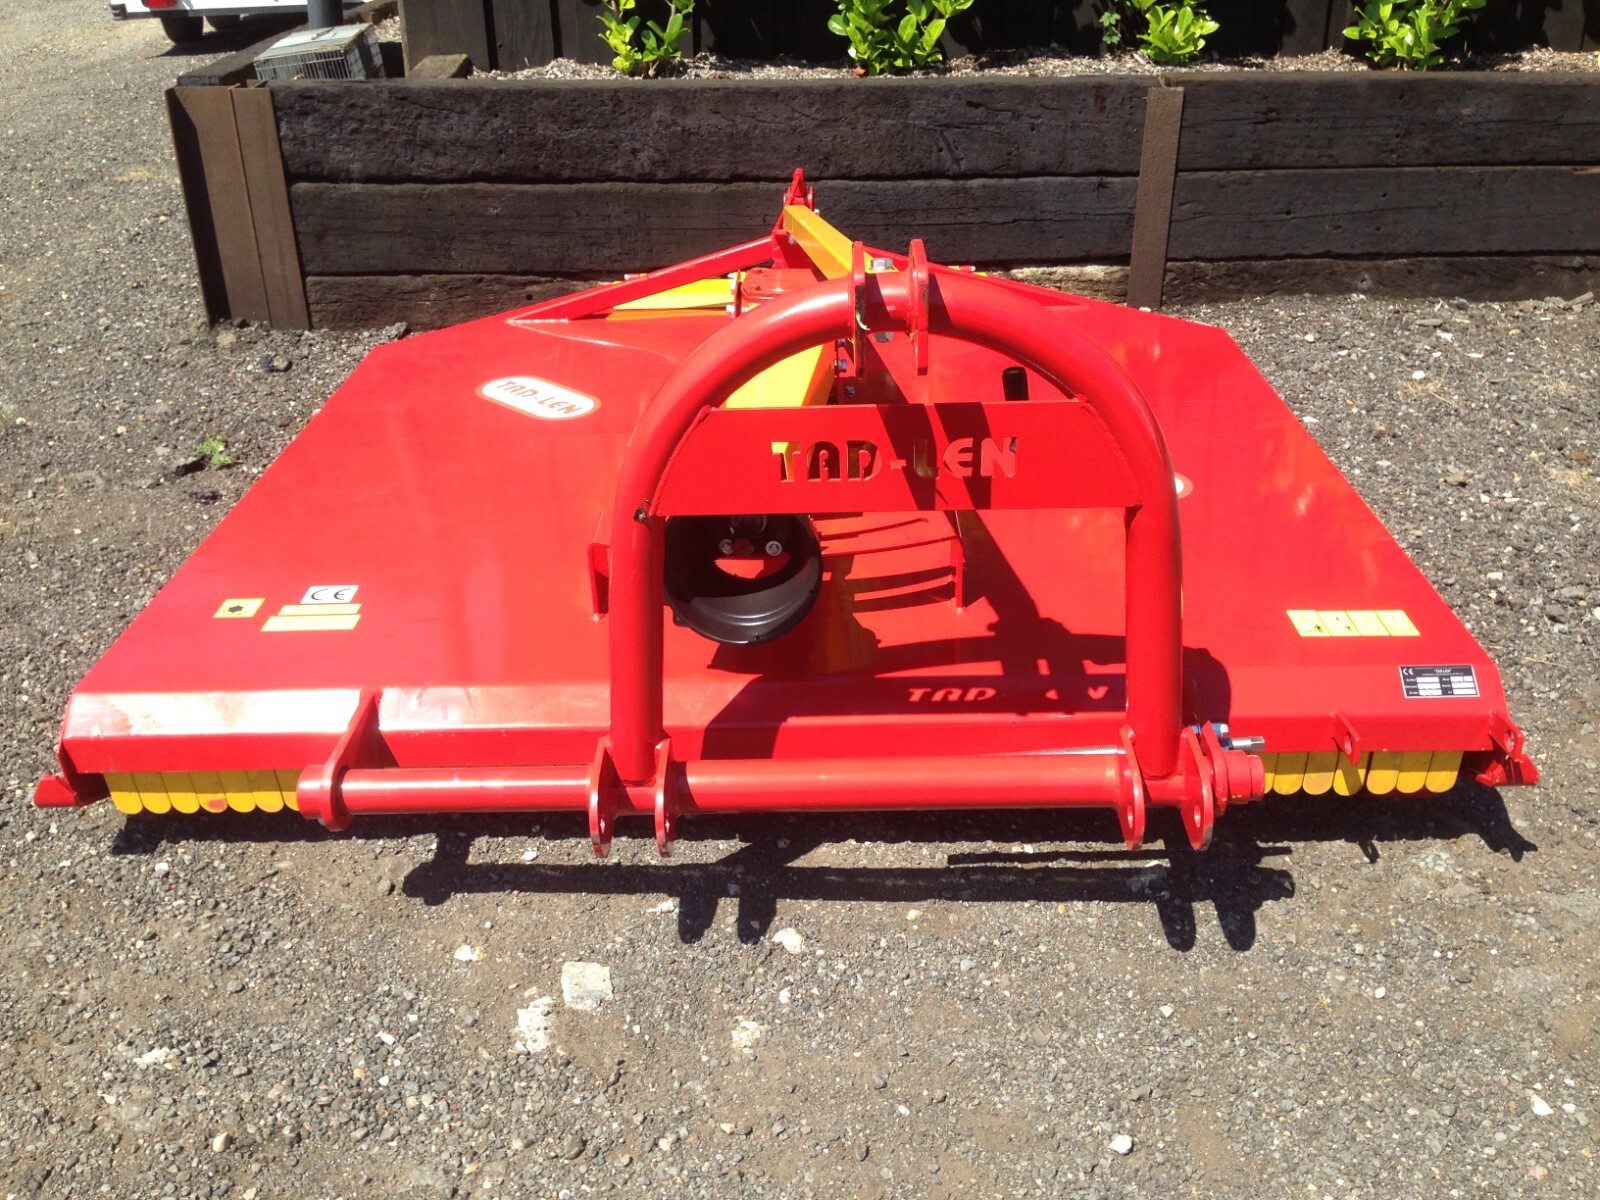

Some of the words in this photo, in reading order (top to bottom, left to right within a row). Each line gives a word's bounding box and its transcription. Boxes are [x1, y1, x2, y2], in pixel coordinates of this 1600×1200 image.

[496, 381, 582, 414] TAD-LEN
[771, 437, 1017, 483] TAD-LEN
[311, 588, 351, 601] CE
